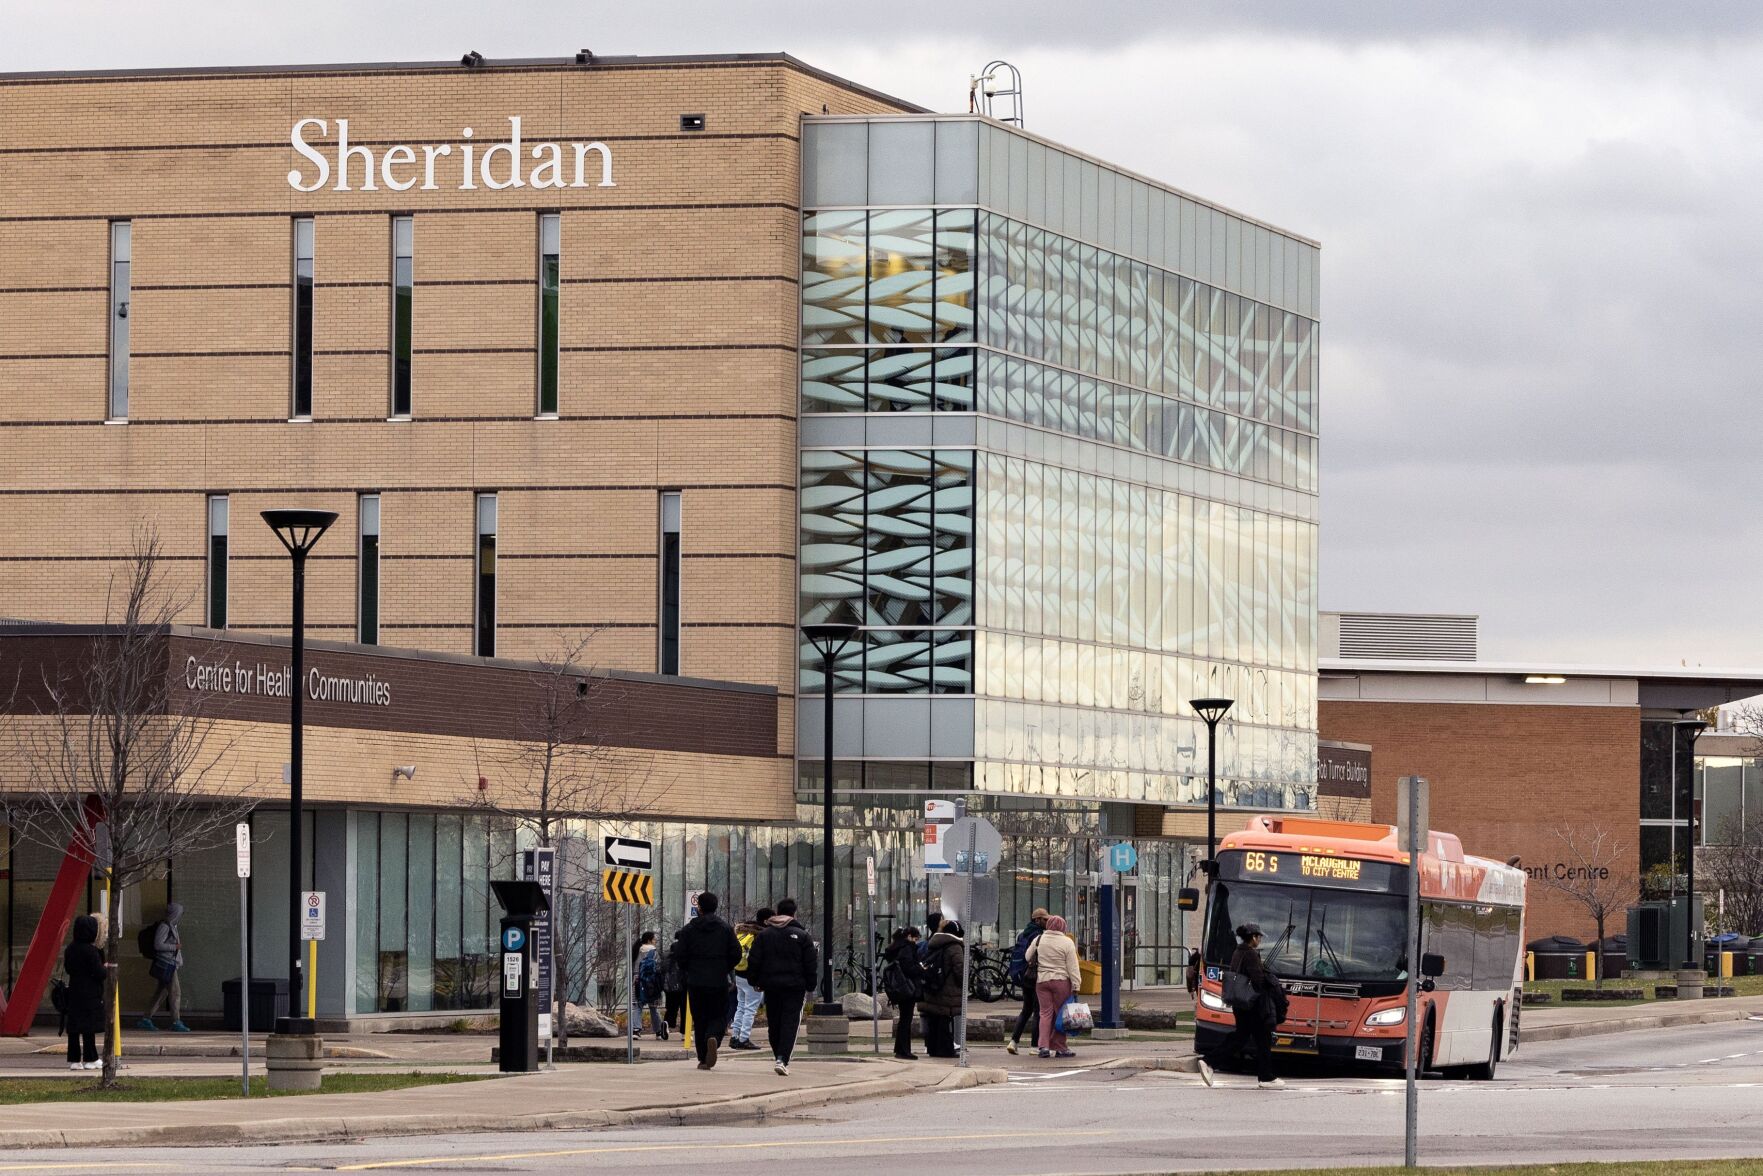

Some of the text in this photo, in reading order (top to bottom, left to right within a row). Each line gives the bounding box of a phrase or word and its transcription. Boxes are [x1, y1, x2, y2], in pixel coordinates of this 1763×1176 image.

[287, 116, 617, 192] Sheridan
[185, 655, 391, 706] Centre for Healt Communities
[1346, 761, 1368, 788] Building
[1115, 848, 1130, 866] H
[1245, 851, 1278, 873] 66 S
[1301, 855, 1361, 871] MCLAUGHLIN
[1302, 866, 1360, 880] TO CITY CENTRE
[1554, 863, 1609, 880] Centre
